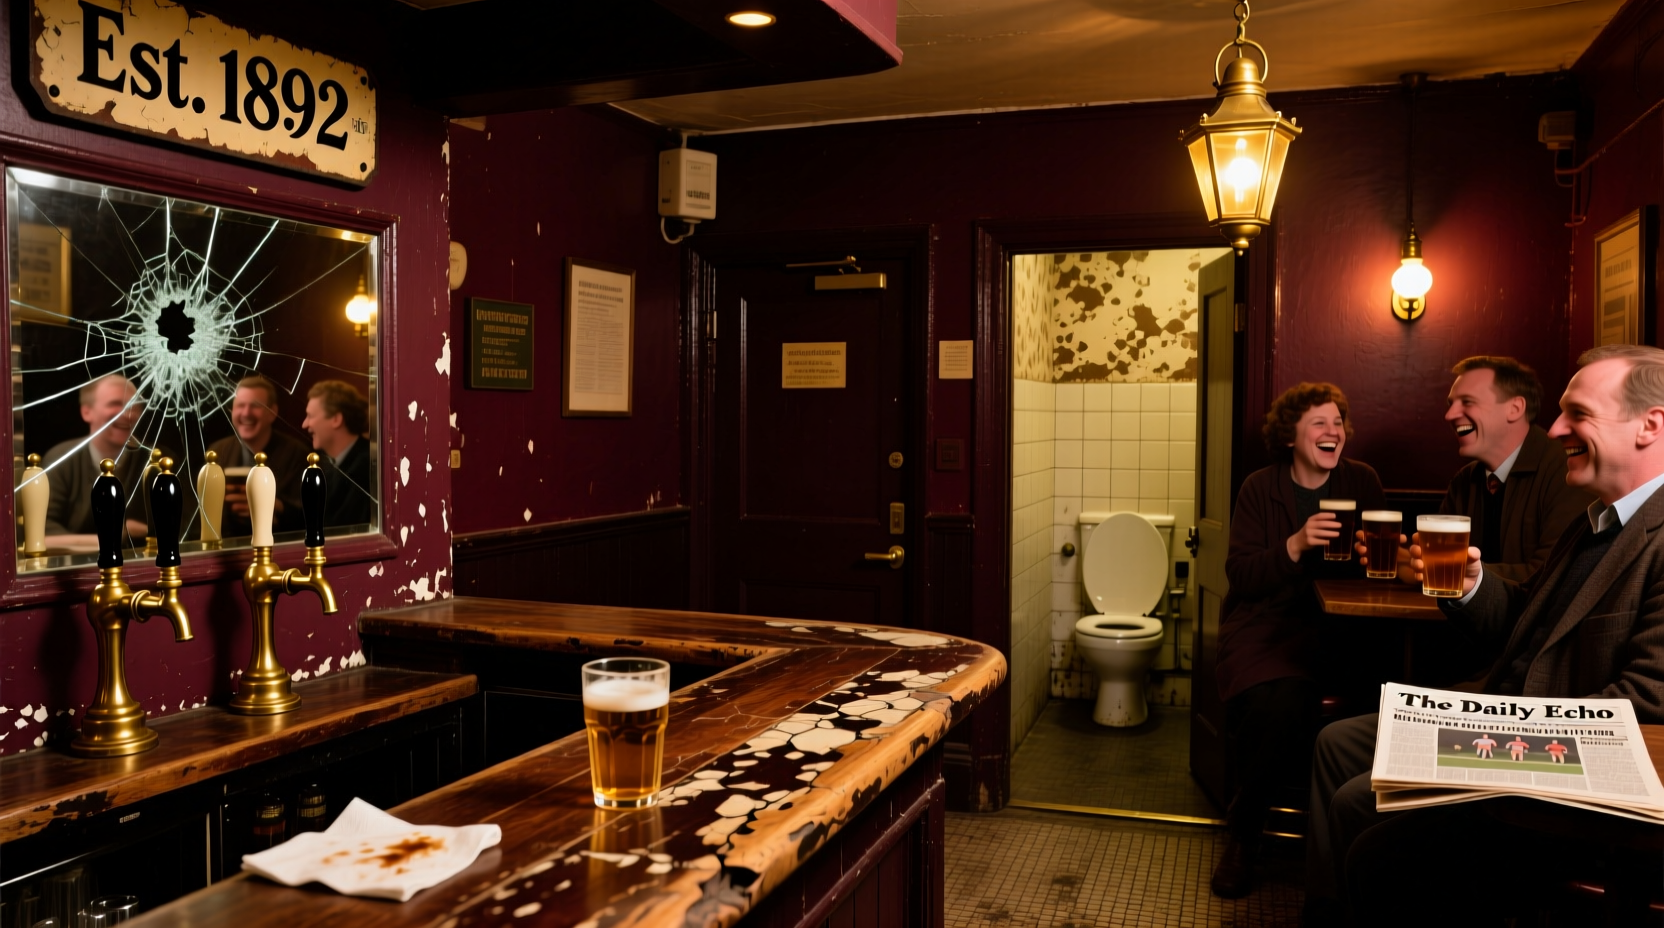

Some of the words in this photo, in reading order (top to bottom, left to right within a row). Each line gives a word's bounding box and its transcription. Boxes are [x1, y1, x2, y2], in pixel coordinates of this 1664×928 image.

[77, 0, 206, 114] Est.
[219, 49, 349, 151] 1892
[1398, 692, 1453, 710] The
[1459, 699, 1536, 720] Daily
[1543, 705, 1614, 719] Echo
